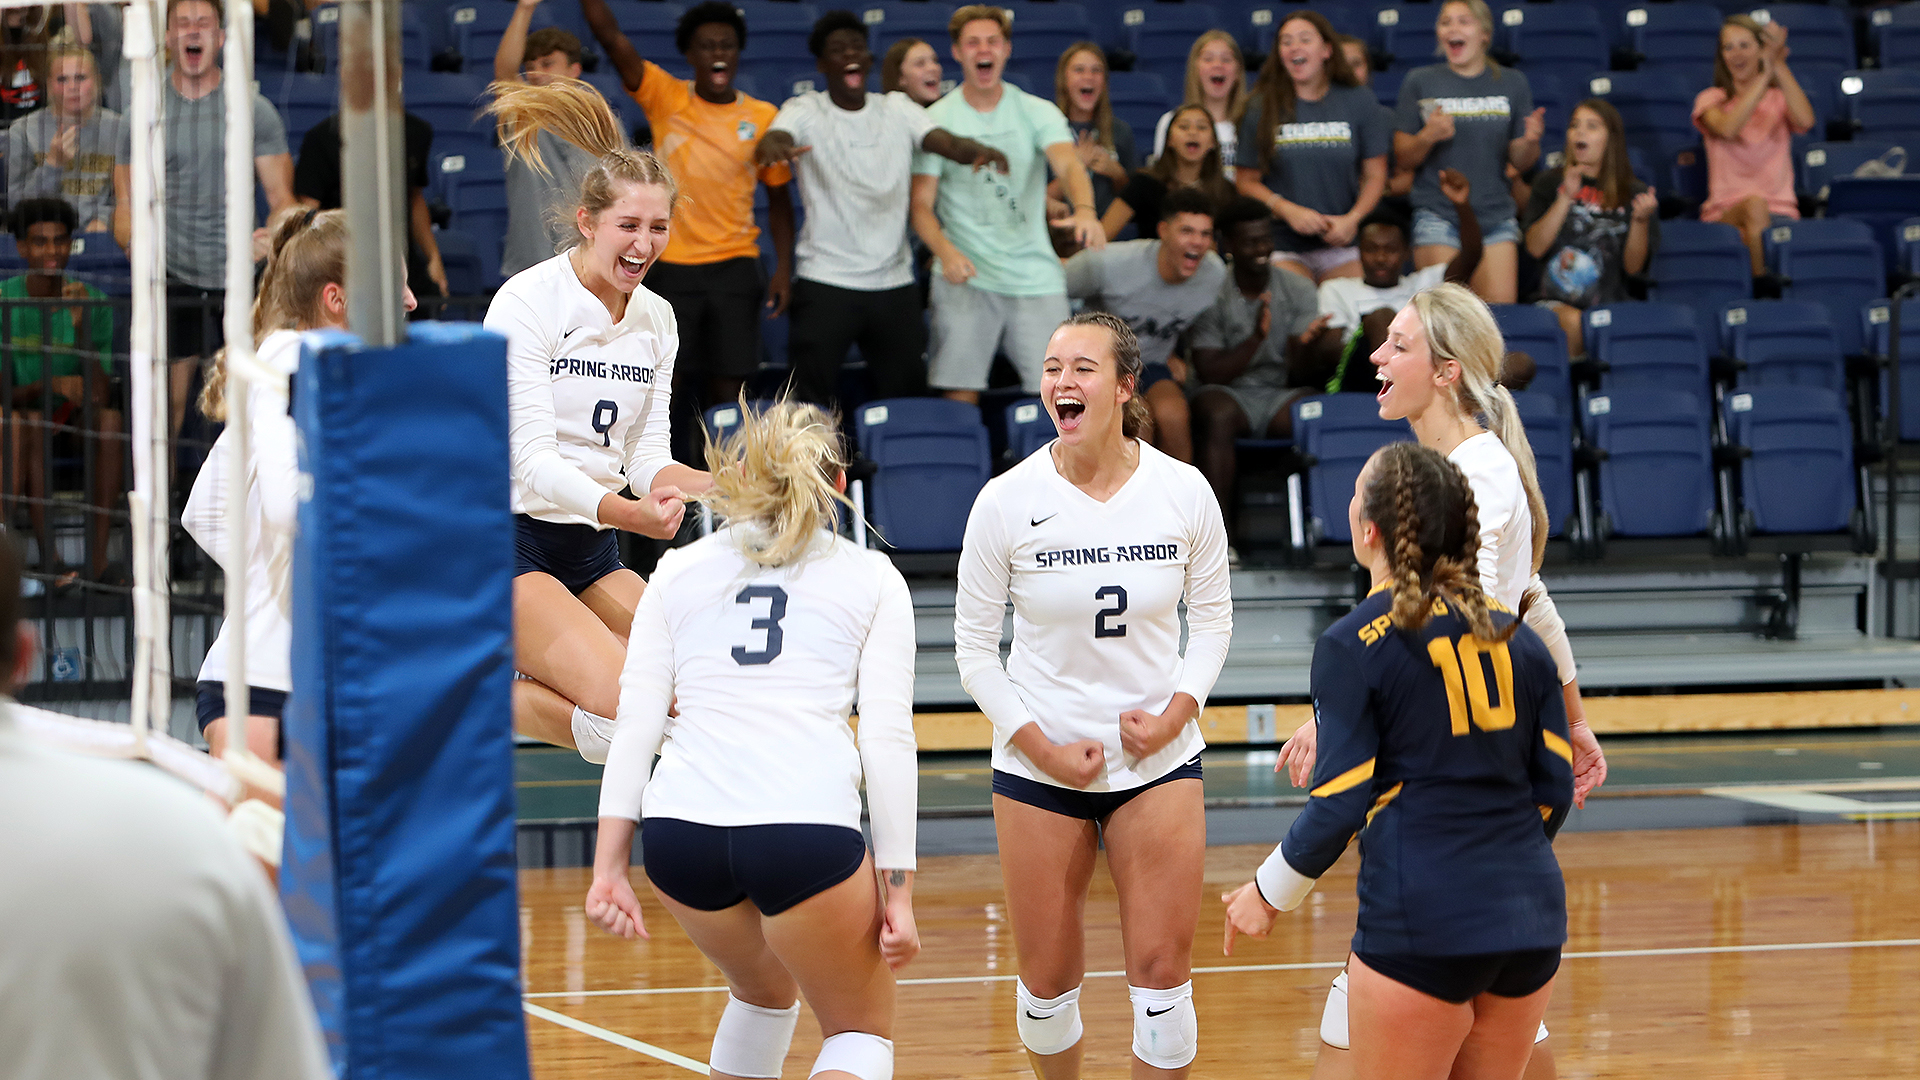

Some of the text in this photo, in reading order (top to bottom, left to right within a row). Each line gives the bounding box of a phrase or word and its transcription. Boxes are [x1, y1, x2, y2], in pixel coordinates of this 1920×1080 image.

[549, 358, 655, 384] SPRING ARBOR
[591, 399, 618, 447] 9
[1035, 544, 1178, 568] SPRING ARBOR
[730, 584, 789, 666] 3
[1095, 585, 1128, 638] 2
[1427, 633, 1517, 737] 10
